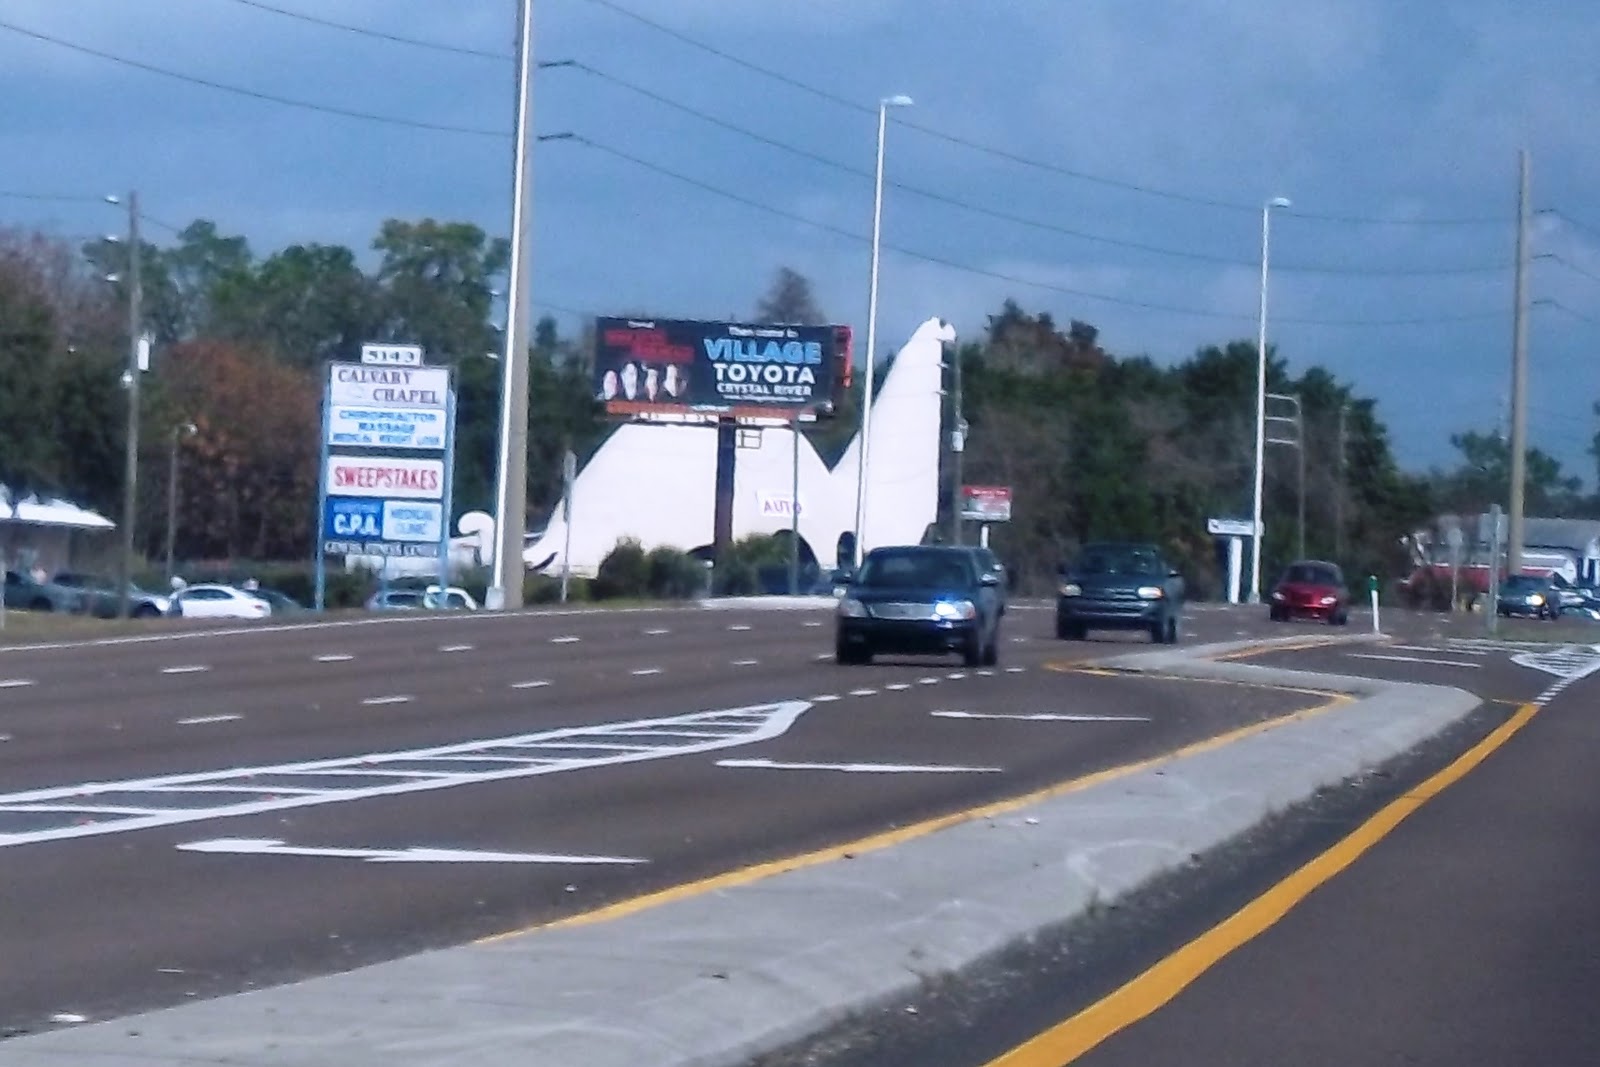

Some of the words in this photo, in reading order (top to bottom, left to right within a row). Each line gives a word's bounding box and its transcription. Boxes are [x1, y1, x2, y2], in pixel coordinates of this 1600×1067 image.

[367, 350, 415, 363] 5143
[703, 338, 822, 364] VILLAGE
[338, 369, 412, 385] CALVARY
[712, 362, 816, 384] TOYOTA
[373, 388, 439, 405] CHAPEL
[716, 382, 771, 395] CRYSTAL
[773, 384, 812, 396] RIVER
[334, 465, 439, 490] SWEEPSTAKES
